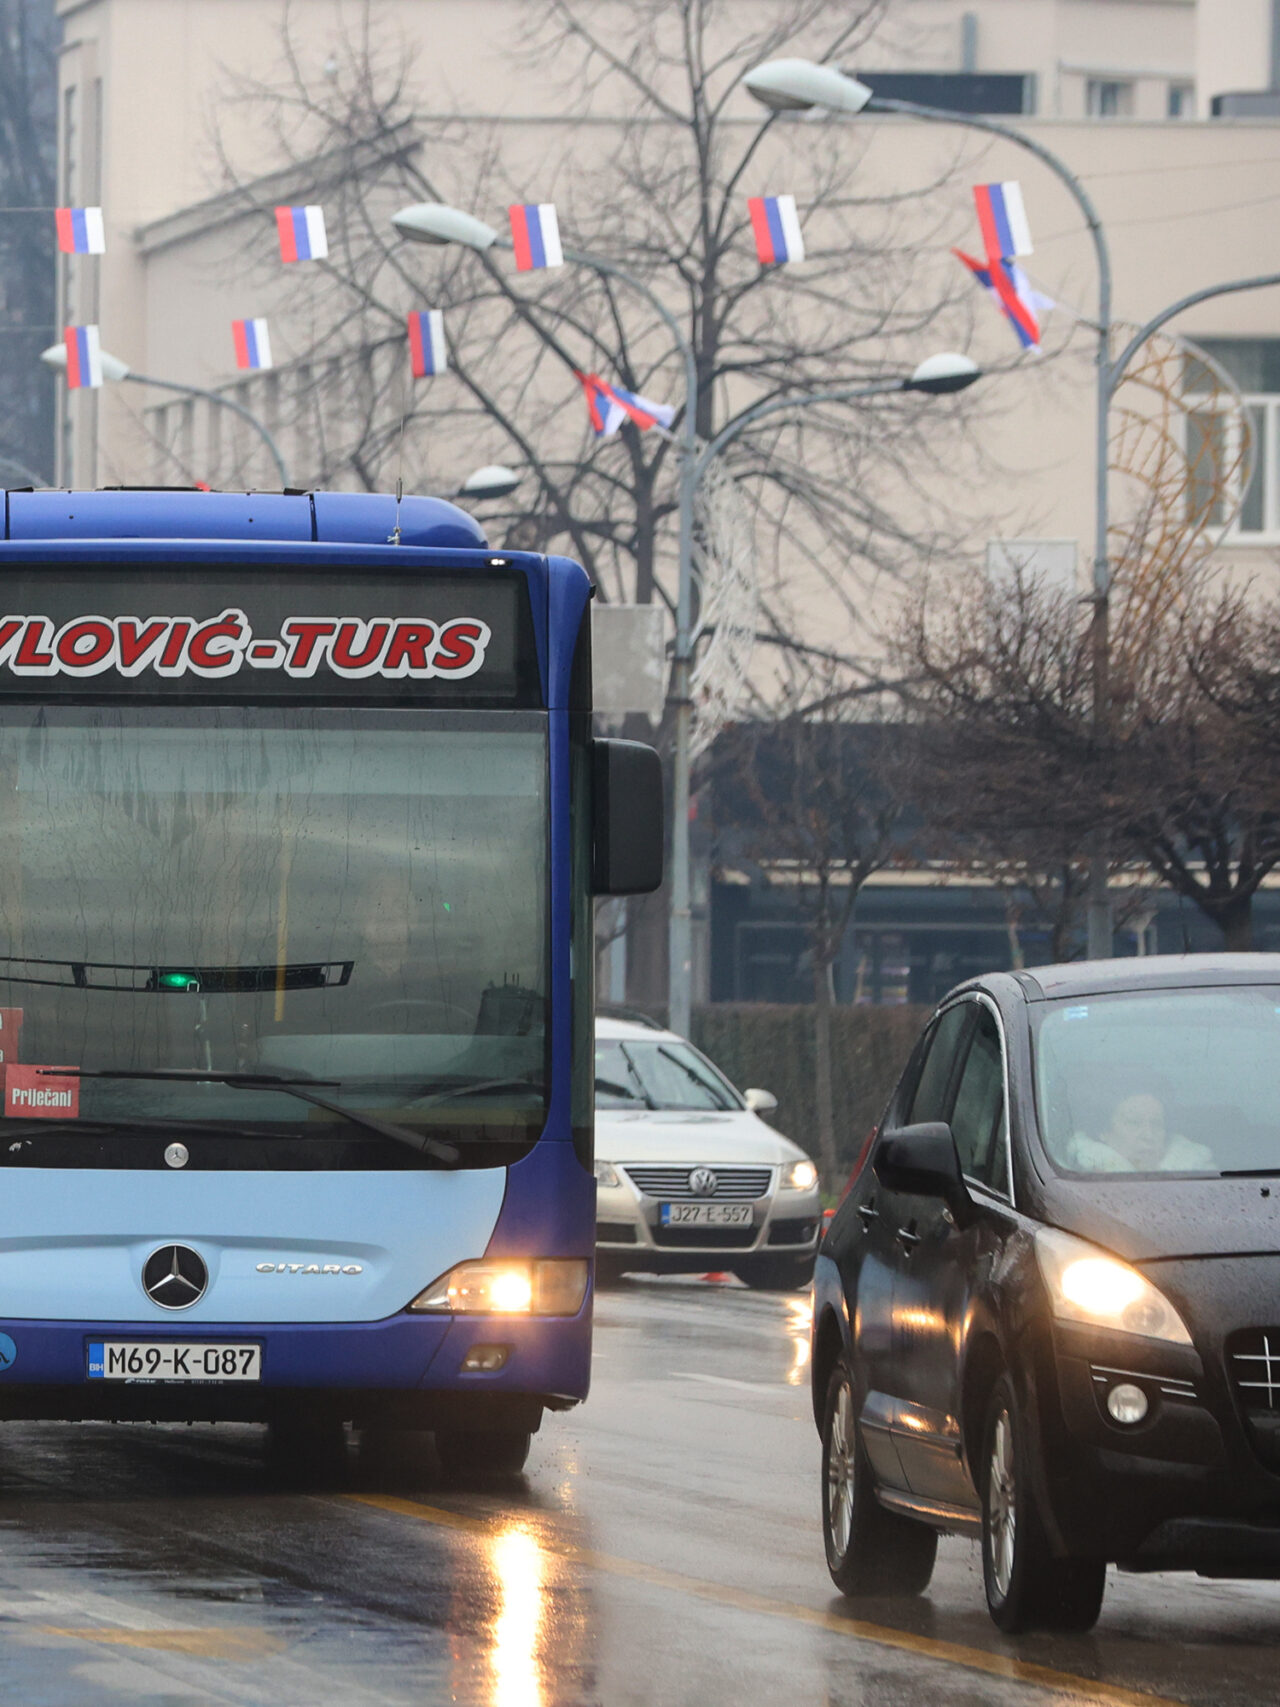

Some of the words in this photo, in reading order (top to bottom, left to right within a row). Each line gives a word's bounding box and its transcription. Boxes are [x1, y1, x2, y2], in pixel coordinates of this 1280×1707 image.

[11, 1088, 72, 1107] Priječani
[672, 1207, 750, 1222] J27-E-557
[256, 1262, 364, 1275] CITARO
[108, 1347, 255, 1375] M69-K-087
